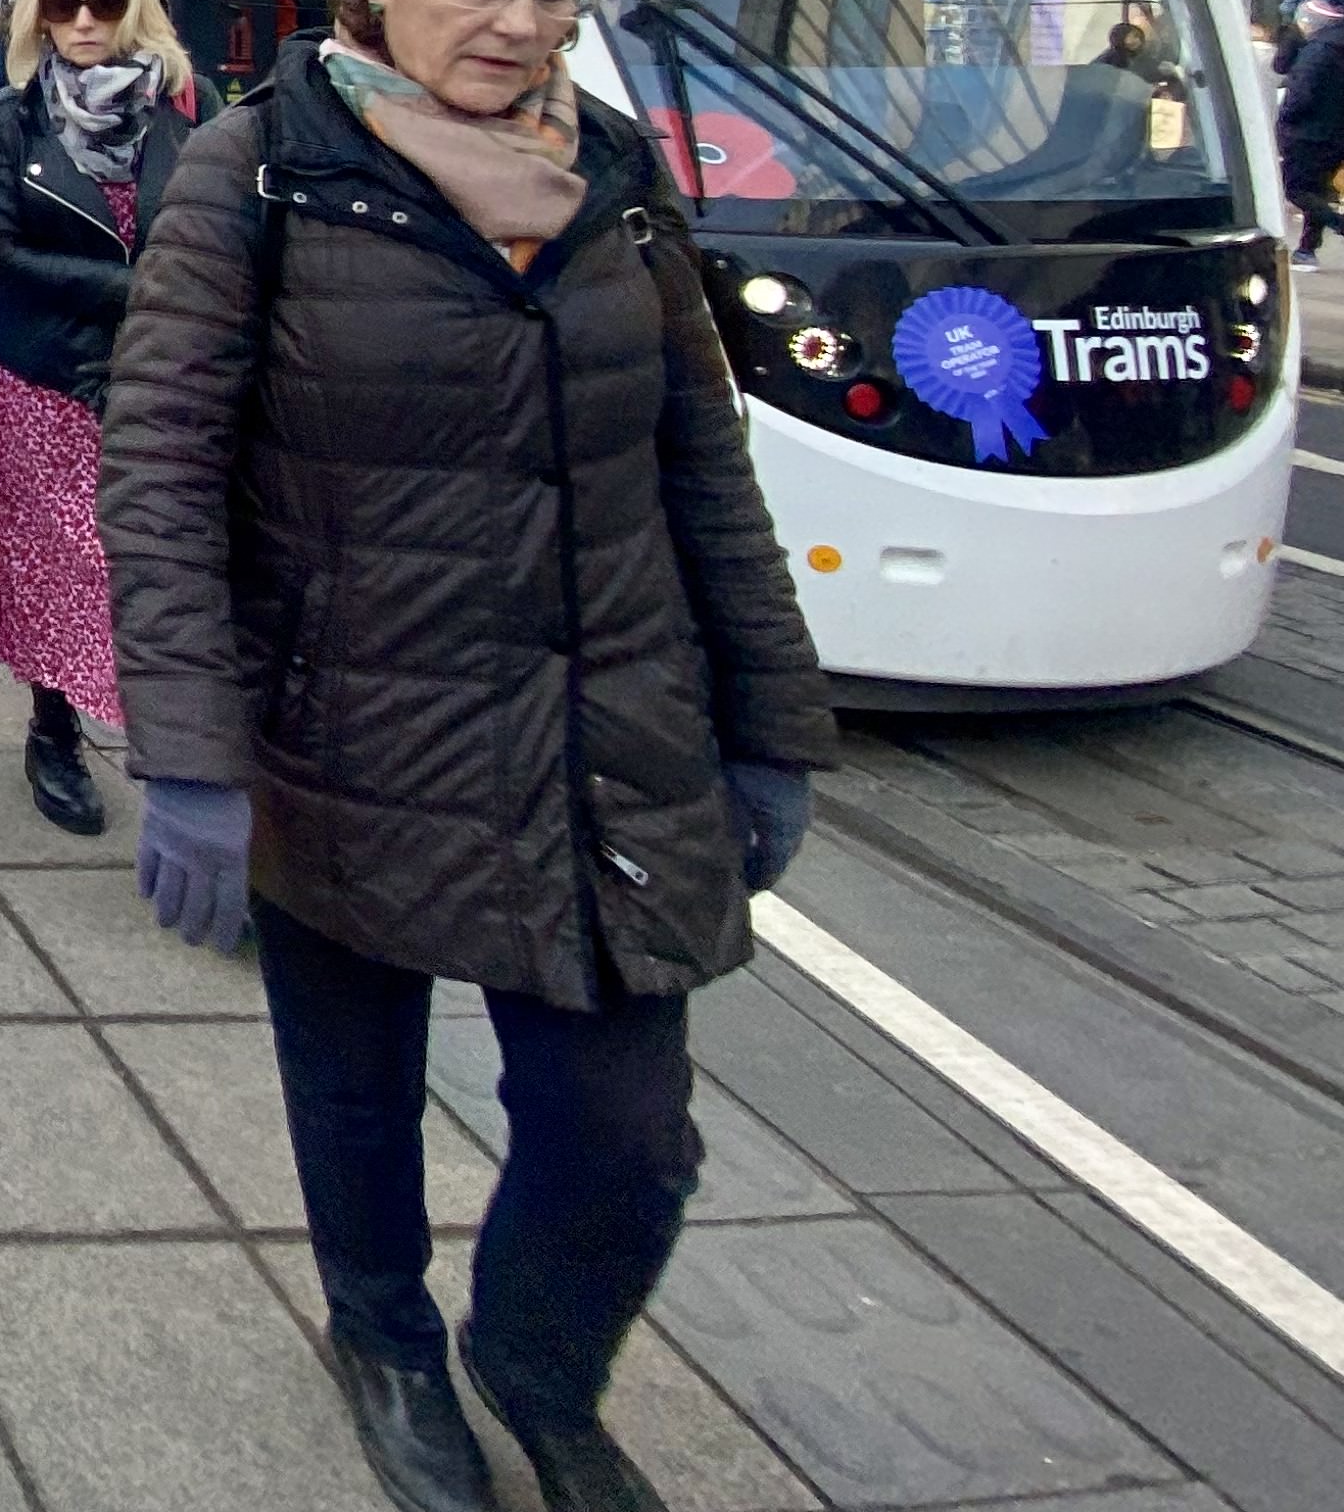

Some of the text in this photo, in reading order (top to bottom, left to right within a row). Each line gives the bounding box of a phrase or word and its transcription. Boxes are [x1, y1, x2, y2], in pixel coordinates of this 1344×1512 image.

[1095, 305, 1201, 334] Edinburgh
[945, 325, 974, 343] UK
[941, 345, 1000, 369] OPERATOR
[950, 340, 983, 356] TRAM
[1032, 319, 1210, 382] Trams
